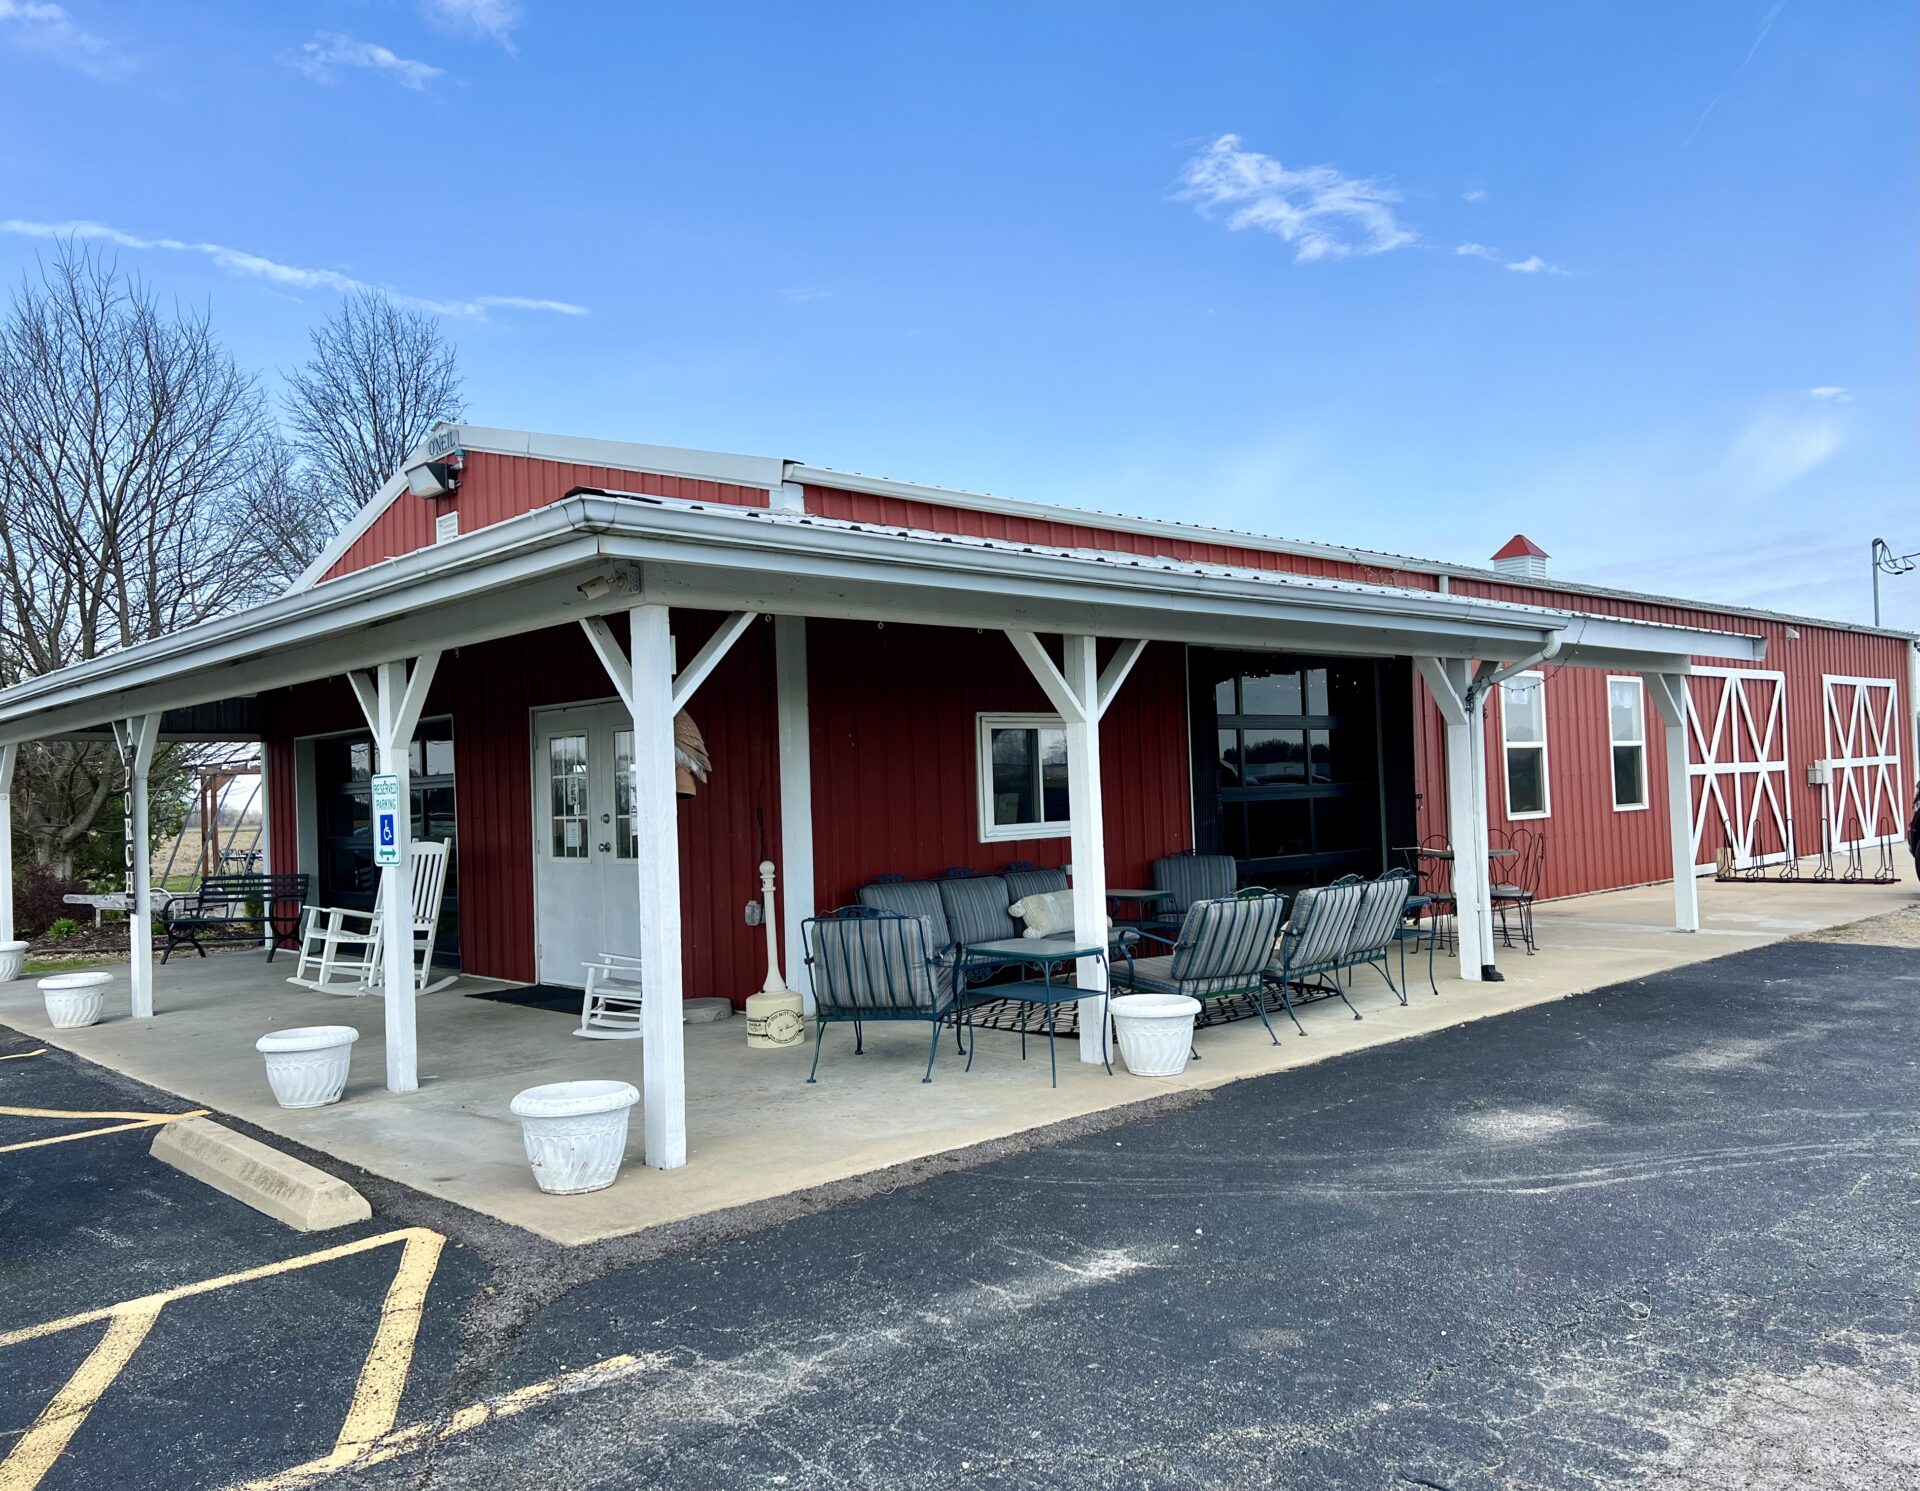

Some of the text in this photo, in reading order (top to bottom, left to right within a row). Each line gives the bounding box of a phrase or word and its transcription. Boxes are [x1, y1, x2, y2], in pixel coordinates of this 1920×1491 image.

[429, 431, 456, 455] O'NEIL
[374, 783, 396, 795] RESERVED
[376, 799, 396, 810] PARKING
[124, 766, 135, 894] PORCH
